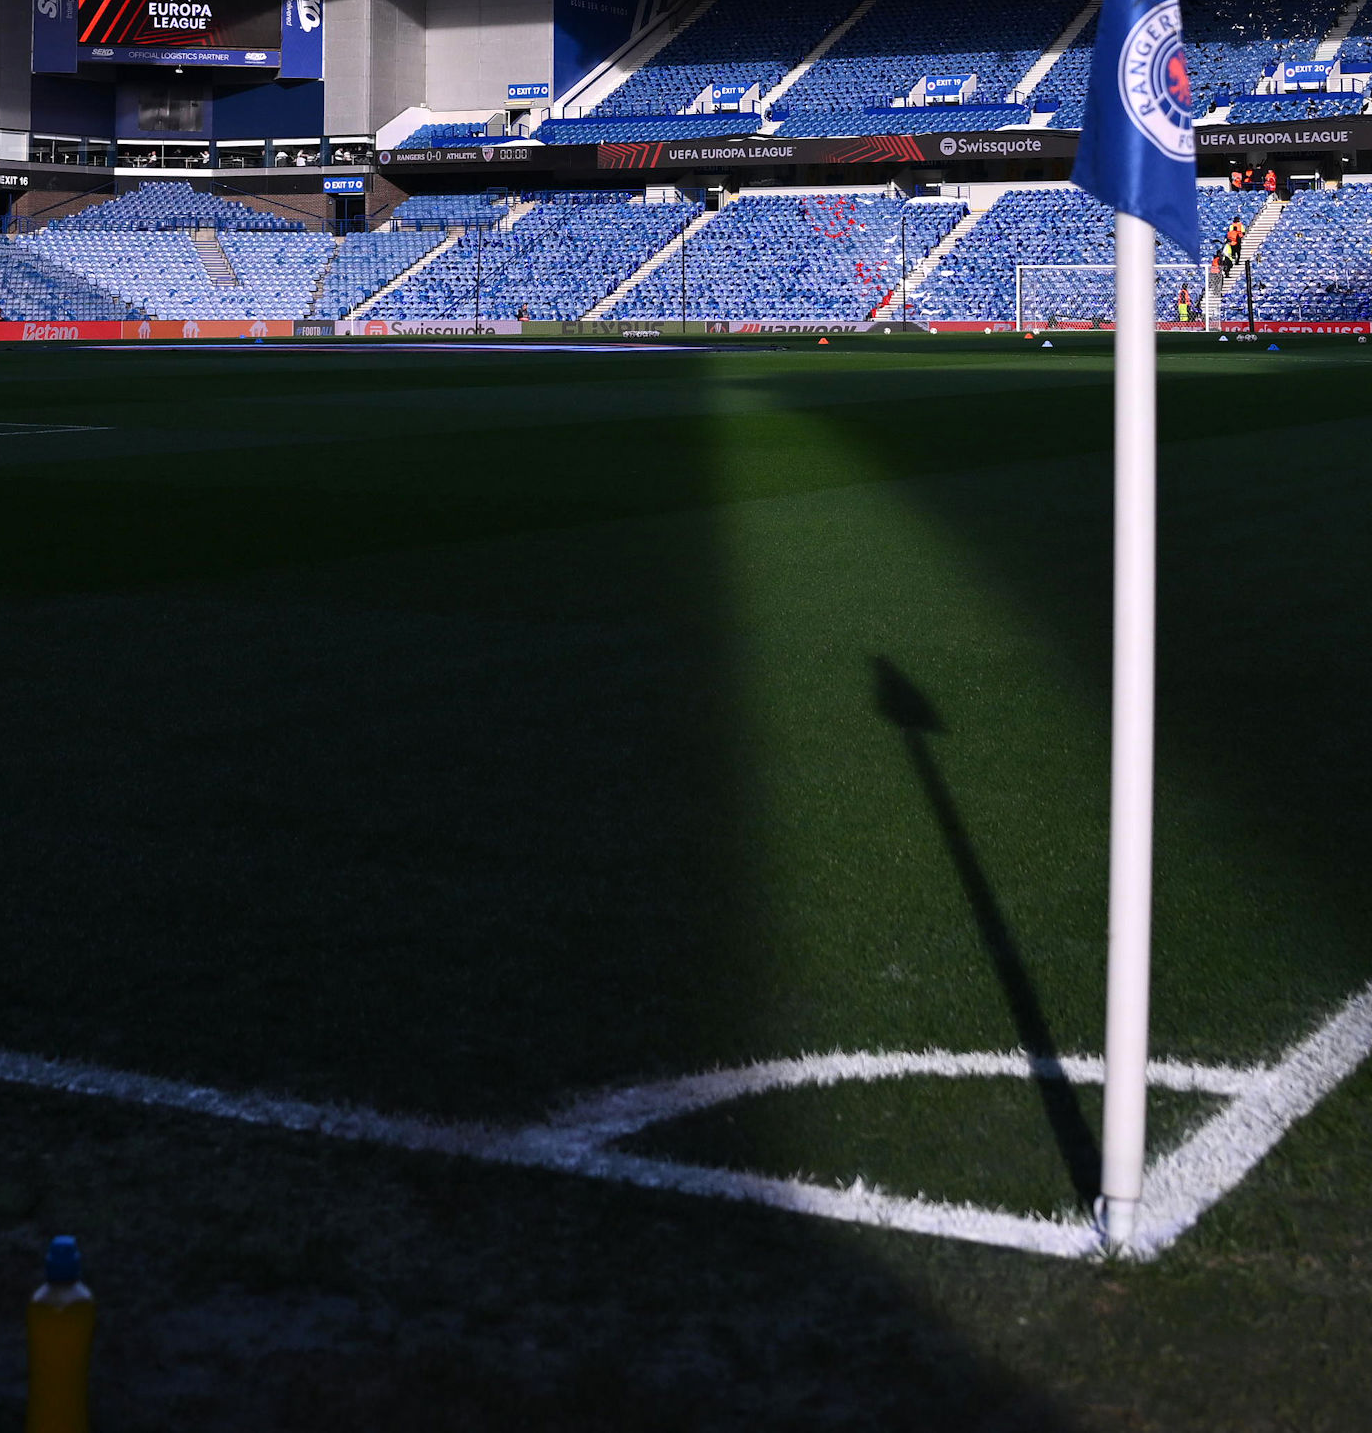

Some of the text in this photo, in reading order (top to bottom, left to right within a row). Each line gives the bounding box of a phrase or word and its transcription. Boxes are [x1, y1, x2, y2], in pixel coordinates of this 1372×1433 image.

[149, 3, 212, 17] EUROPA
[154, 17, 207, 29] LEAGUE
[161, 52, 197, 60] LOGISTICS
[199, 53, 229, 61] PARTNER
[1295, 65, 1313, 73] EXIT
[517, 87, 540, 95] EXIT 17
[1200, 131, 1349, 145] UEFA EUROPA LEAGUE
[958, 138, 1042, 156] Swissquote
[427, 151, 441, 161] 0-0
[447, 152, 477, 160] ATHLETIC
[500, 149, 528, 160] 00:00
[669, 147, 793, 160] UEFA EUROPA LEAGUE
[0, 176, 29, 186] EXIT 16
[332, 181, 355, 189] EXIT 17
[23, 323, 78, 341] Betano
